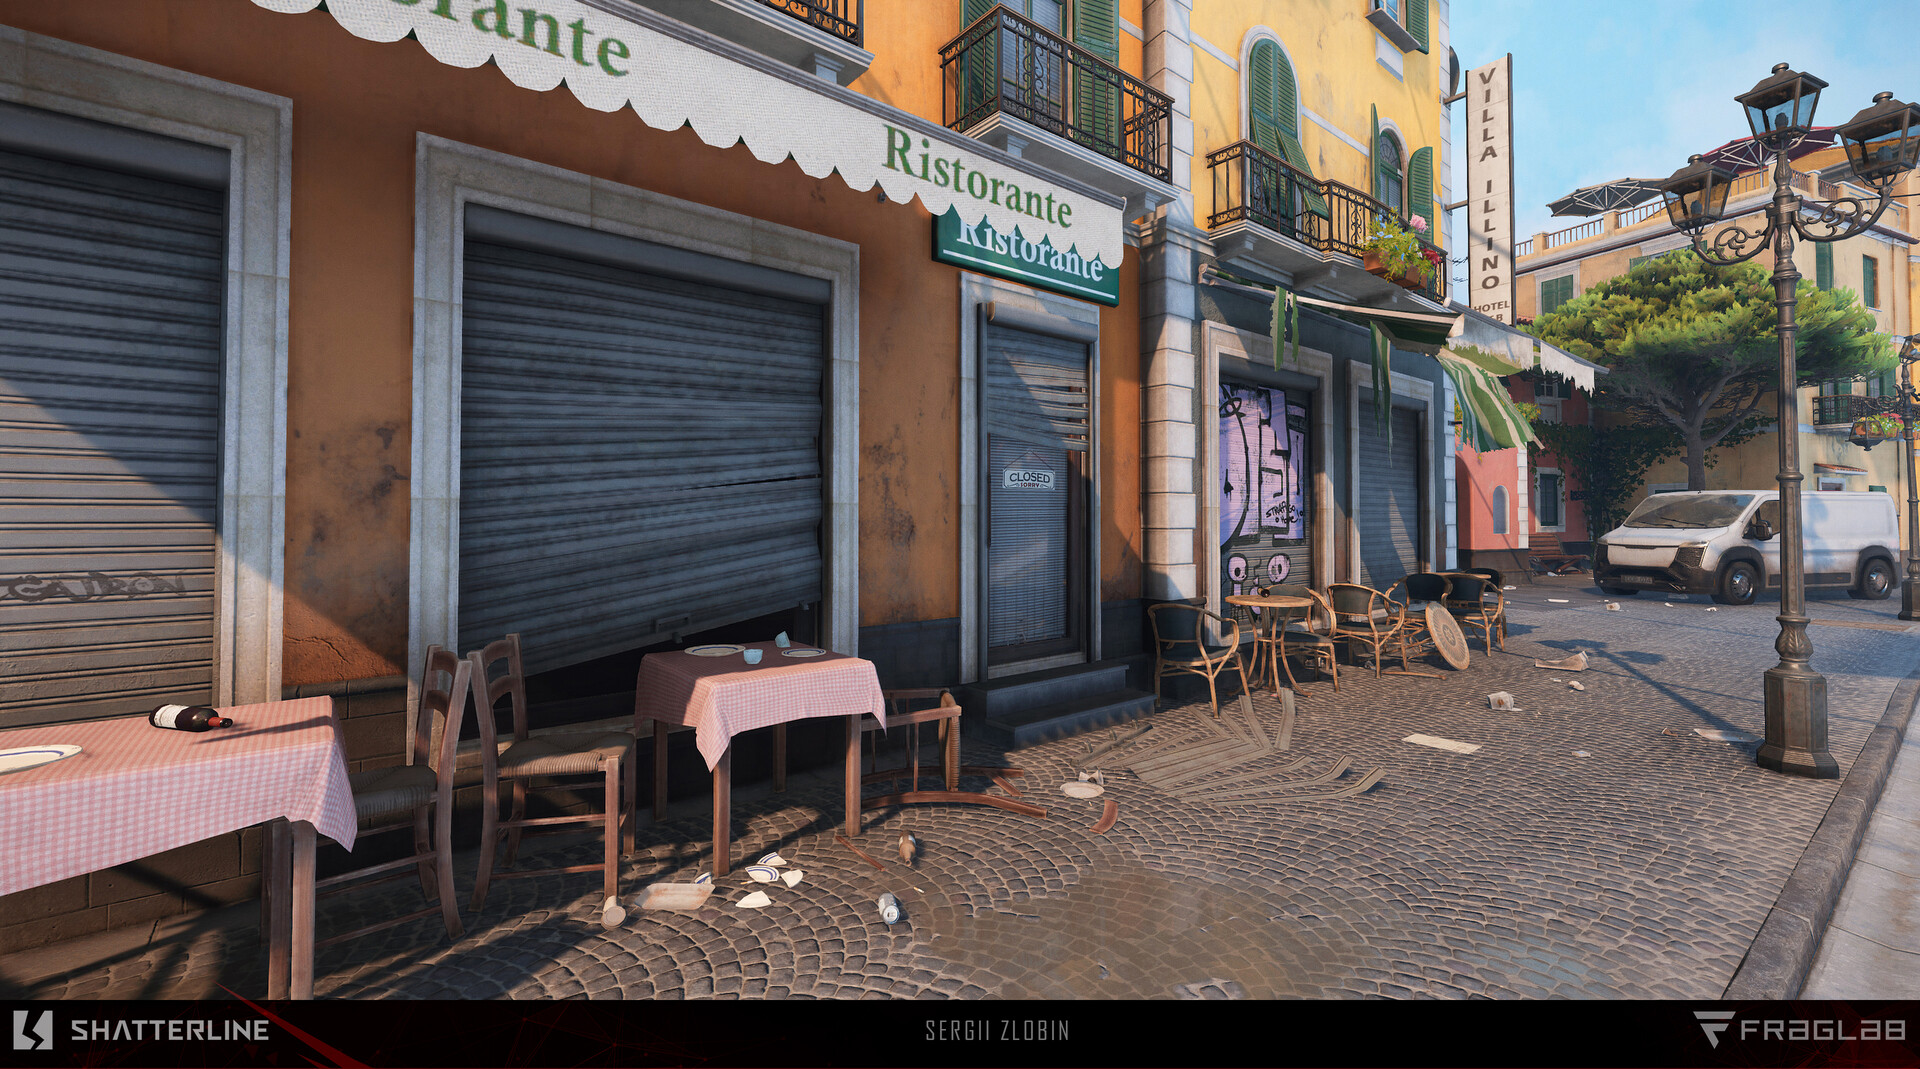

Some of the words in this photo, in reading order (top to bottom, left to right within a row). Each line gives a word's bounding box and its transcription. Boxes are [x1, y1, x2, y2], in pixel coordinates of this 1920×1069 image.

[1479, 67, 1498, 162] VILLA
[882, 124, 1072, 228] Ristorante
[1482, 180, 1500, 290] ILLINO
[1474, 301, 1511, 313] HOTEL
[1009, 472, 1051, 483] CLOSED
